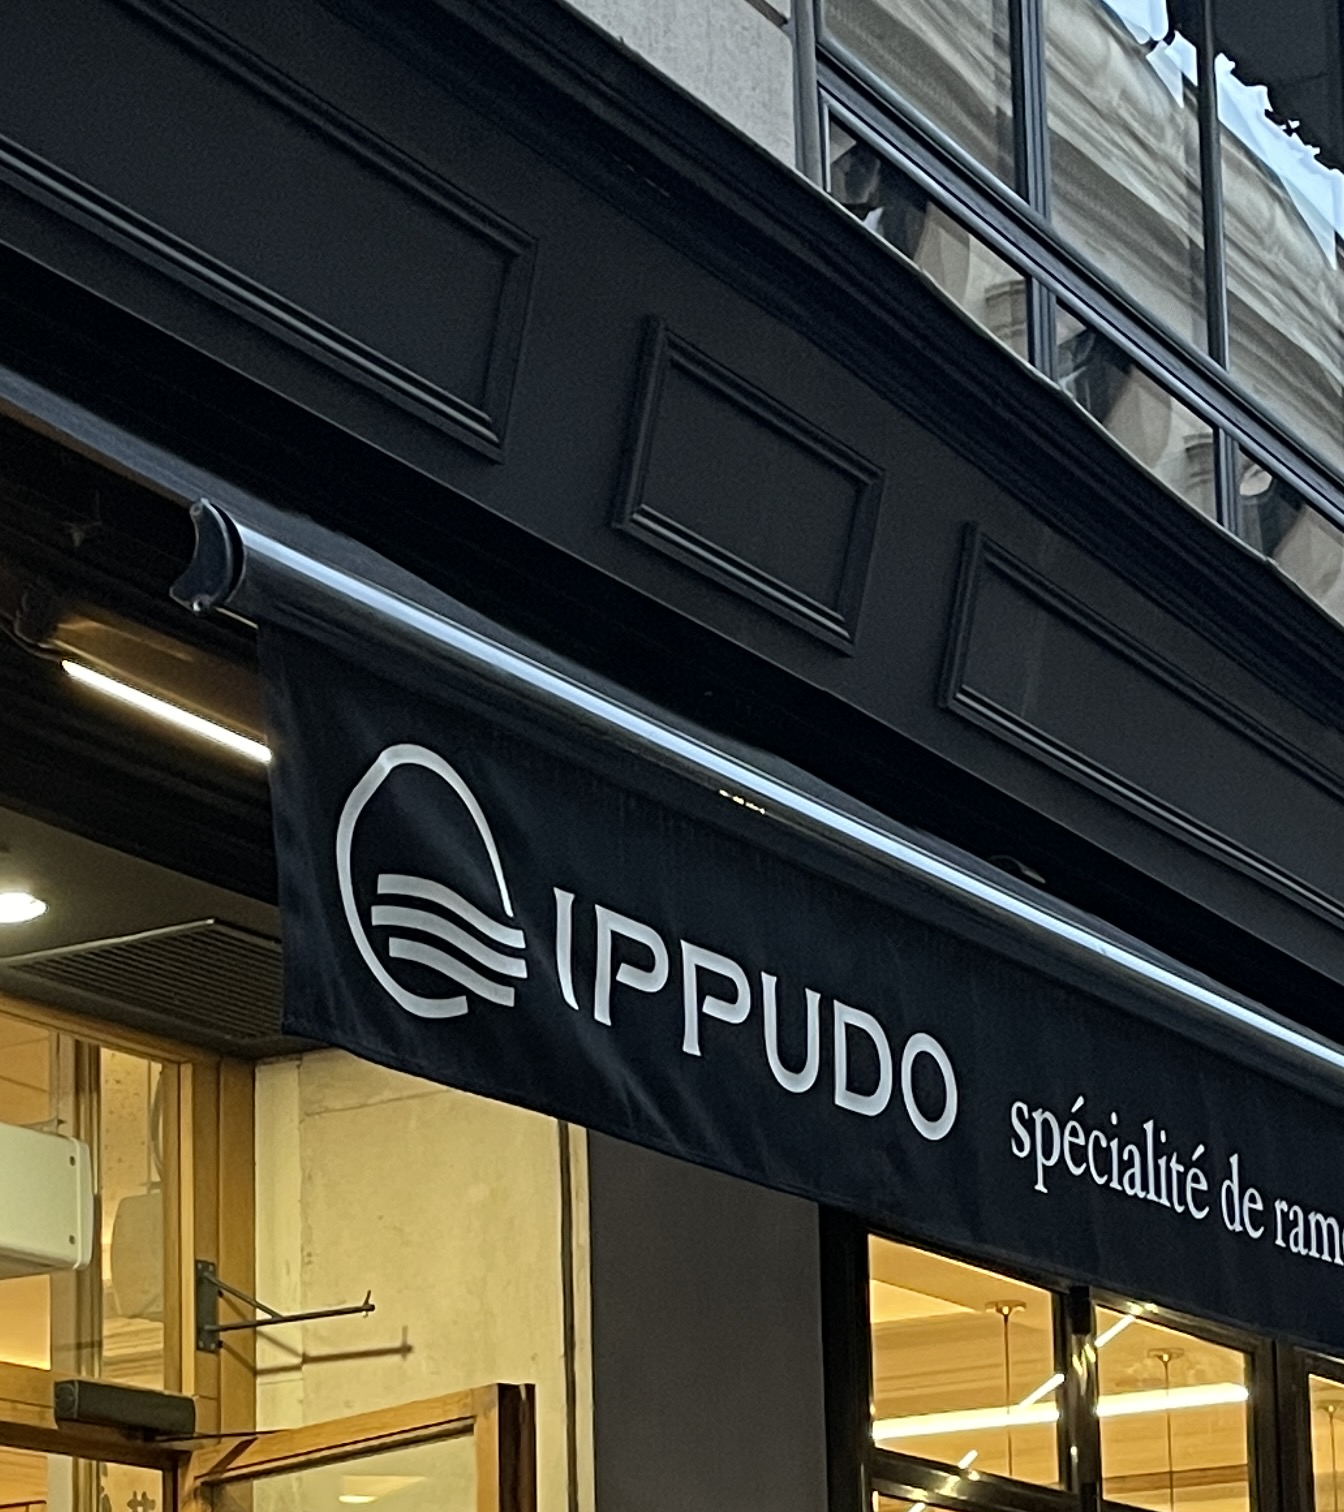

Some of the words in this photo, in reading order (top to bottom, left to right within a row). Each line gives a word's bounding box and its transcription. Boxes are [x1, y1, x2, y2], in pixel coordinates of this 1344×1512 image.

[553, 887, 958, 1141] IPPUDO
[1011, 1095, 1210, 1221] spécialité
[1221, 1153, 1265, 1239] de
